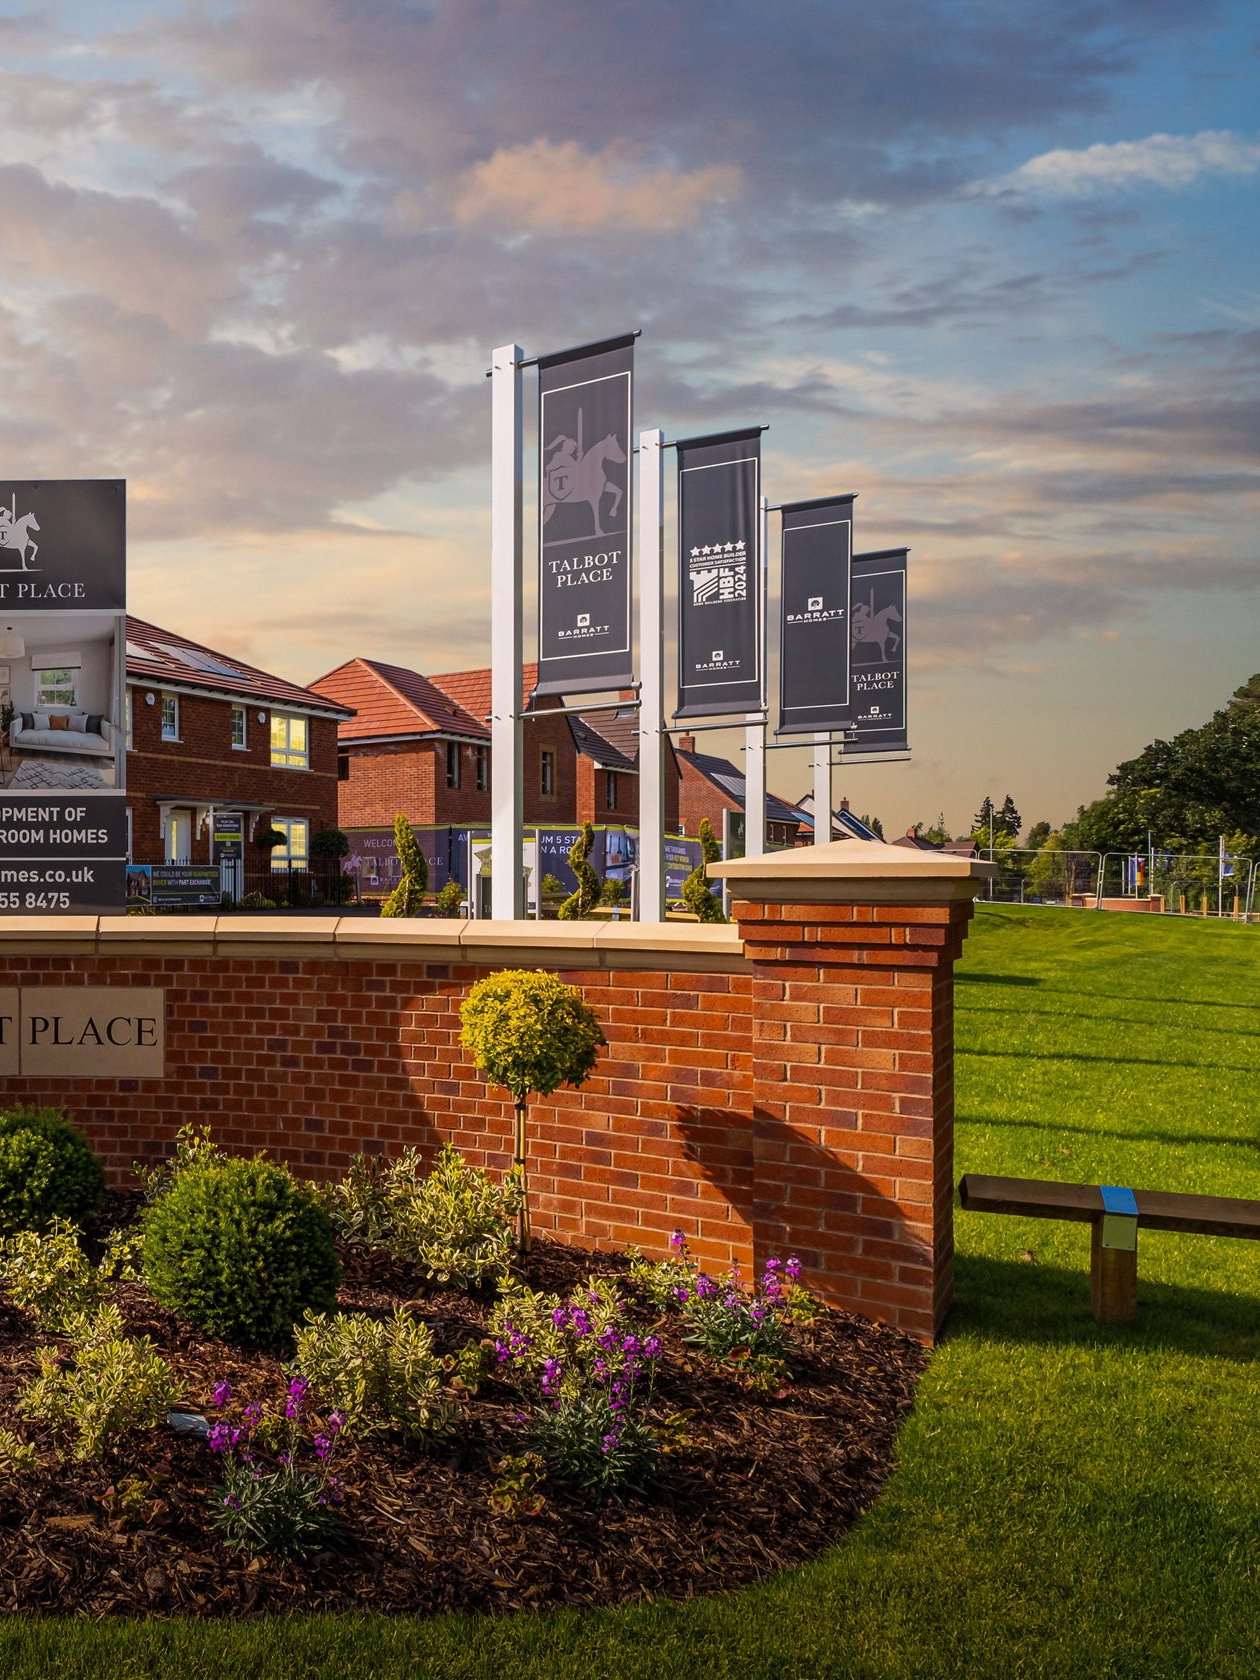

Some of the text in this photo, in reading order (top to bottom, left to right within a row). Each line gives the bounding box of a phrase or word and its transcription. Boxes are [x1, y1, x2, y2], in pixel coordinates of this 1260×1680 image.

[554, 476, 568, 491] T
[549, 550, 621, 573] TALBOT
[556, 568, 613, 588] PLACE
[720, 568, 734, 599] HBF
[735, 566, 746, 597] 2024
[17, 583, 85, 598] PLACE
[787, 609, 844, 621] BARRATT
[558, 625, 609, 637] BARRATT
[695, 660, 740, 669] BARRATT
[851, 671, 899, 682] TALBOT
[857, 681, 894, 691] PLACE
[64, 808, 86, 821] OF
[49, 830, 108, 843] HOMES
[364, 839, 396, 848] WELCO
[560, 846, 572, 854] RO
[366, 858, 402, 866] TALBO
[25, 893, 70, 909] 8475
[29, 1016, 158, 1046] PLACE
